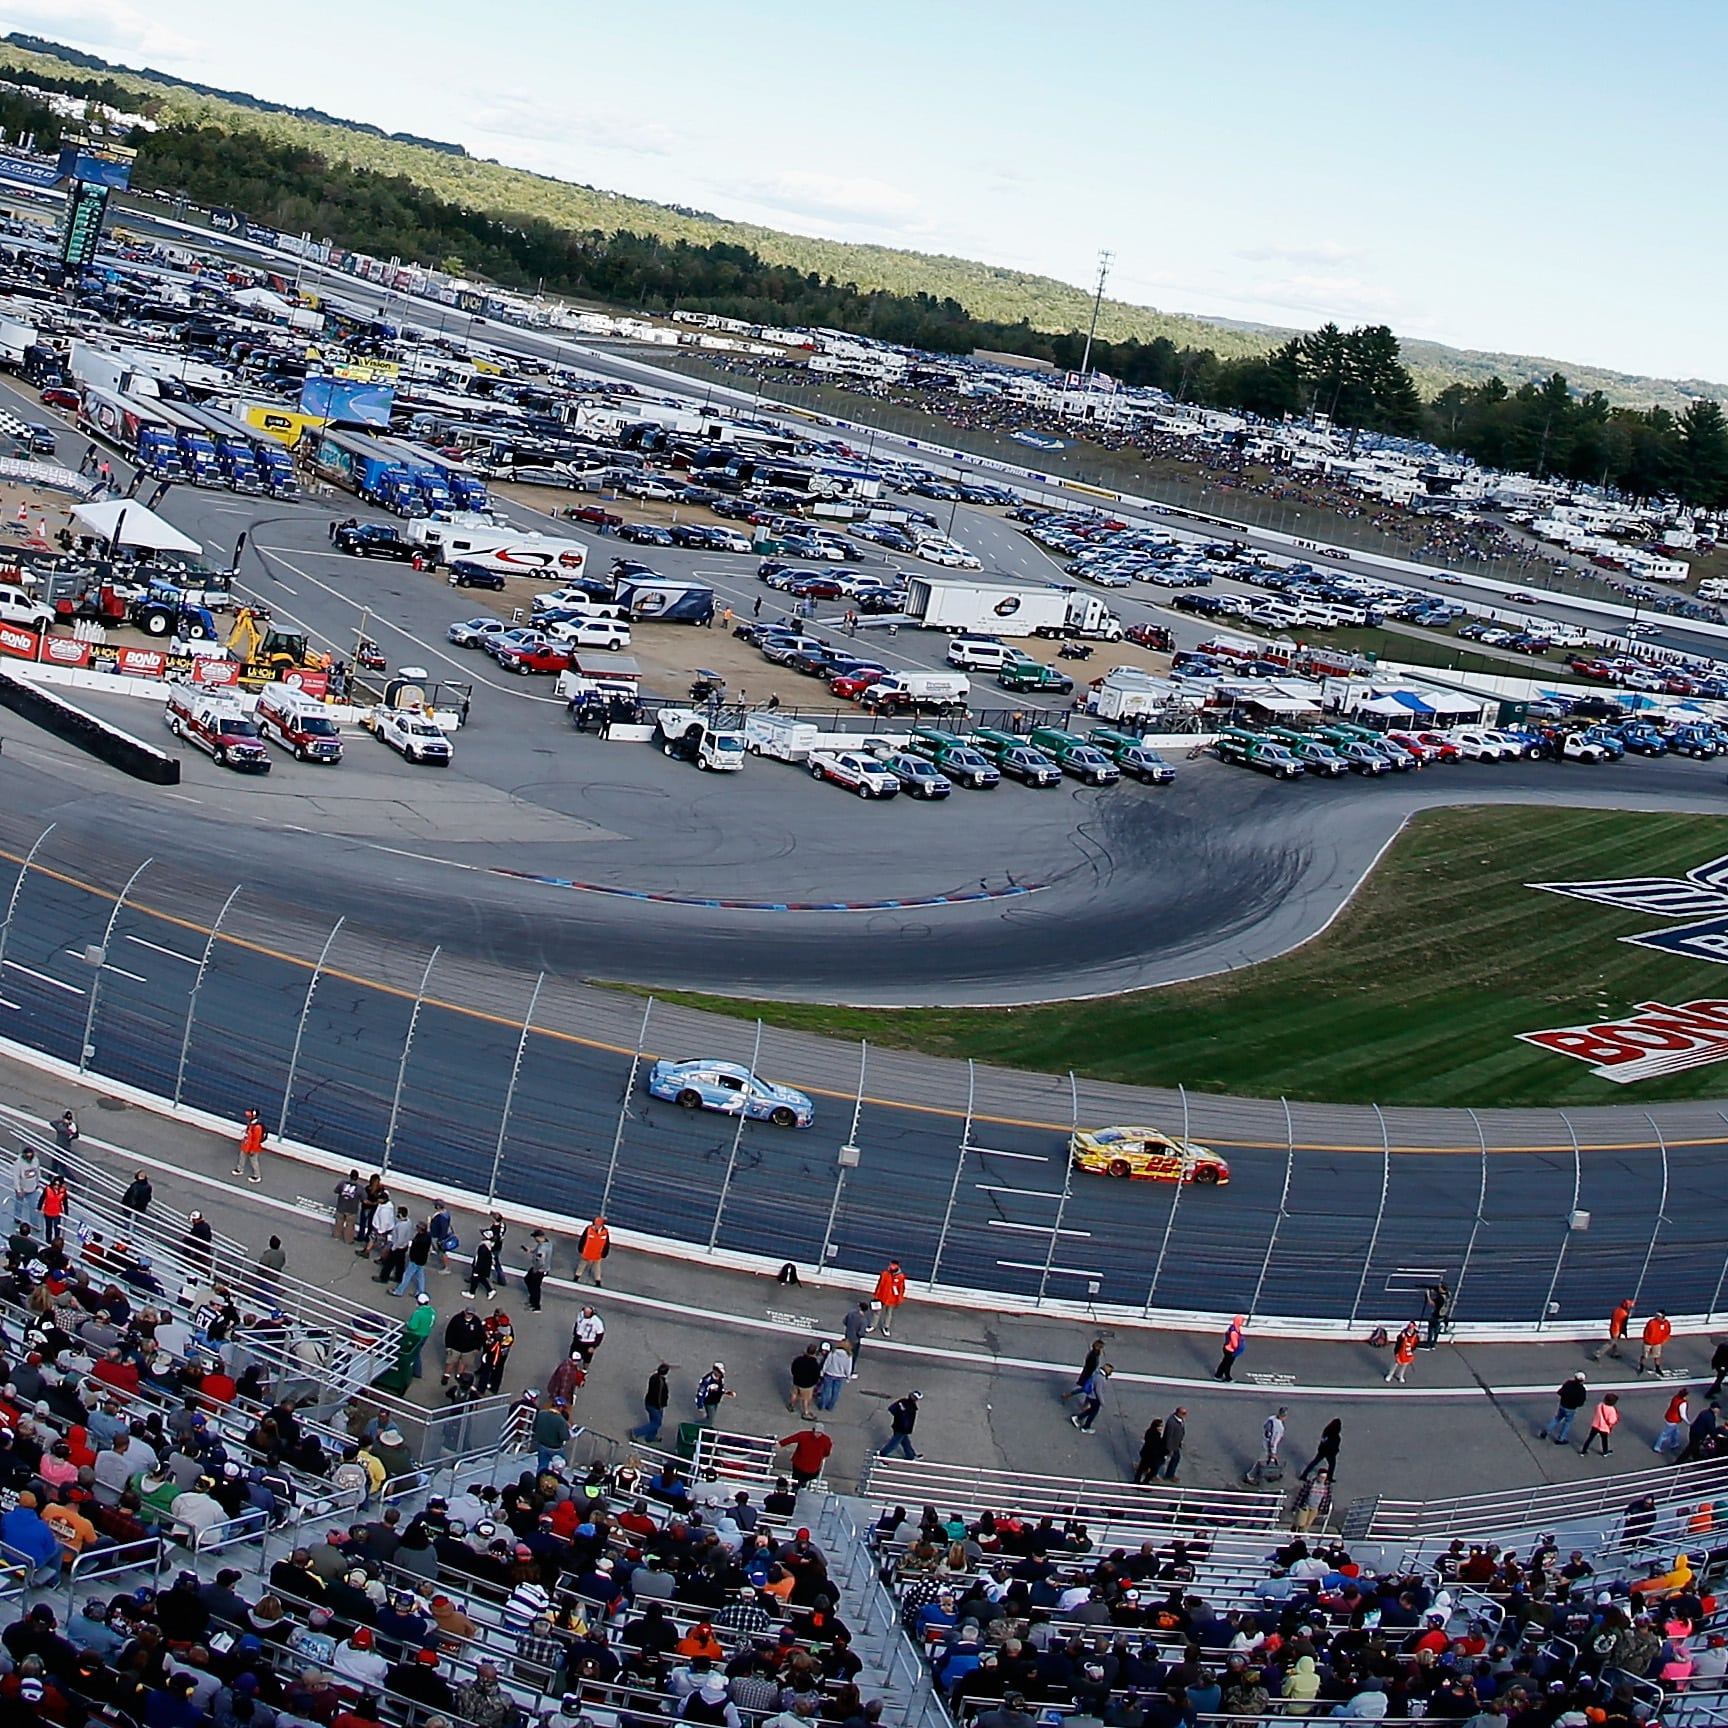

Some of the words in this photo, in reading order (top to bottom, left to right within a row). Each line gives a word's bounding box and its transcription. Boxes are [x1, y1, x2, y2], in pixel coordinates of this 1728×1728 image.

[0, 630, 32, 649] BOND
[90, 645, 120, 659] UNOH
[125, 651, 162, 667] BOND
[165, 656, 195, 669] UNOH
[247, 666, 276, 679] UNOH
[722, 1093, 747, 1110] 5
[1145, 1156, 1179, 1173] 22
